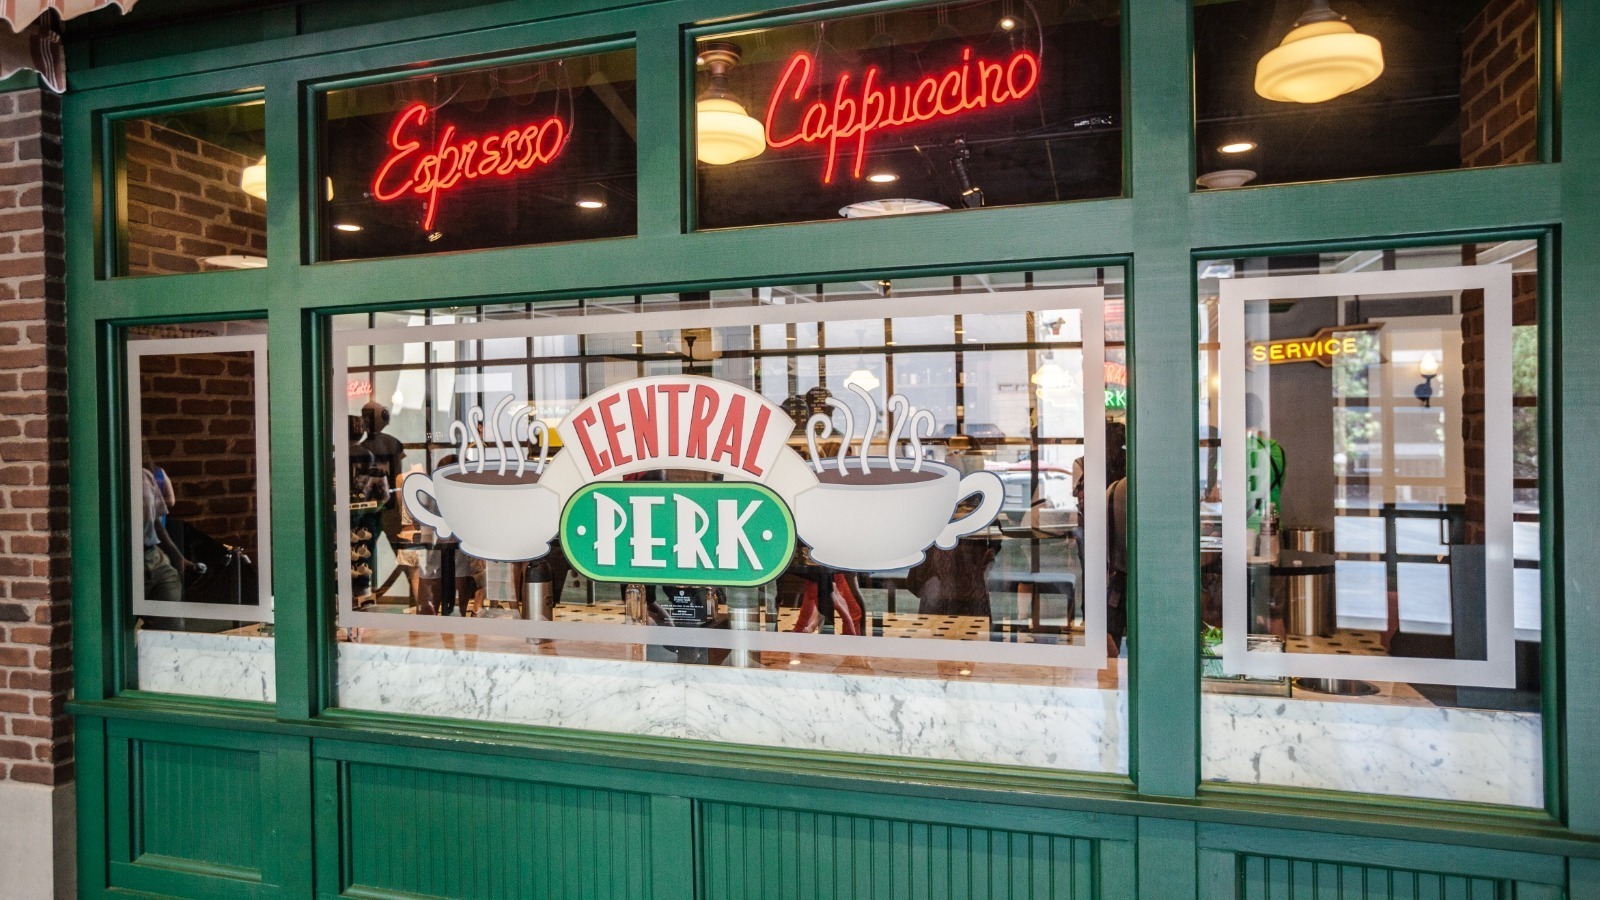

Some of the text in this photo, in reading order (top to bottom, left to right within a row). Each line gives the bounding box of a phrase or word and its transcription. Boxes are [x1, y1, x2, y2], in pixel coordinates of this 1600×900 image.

[765, 48, 1037, 183] Cappuccino
[374, 104, 564, 231] Espresso
[1252, 337, 1357, 361] SERVICE
[571, 383, 772, 477] CENTRAL
[1104, 390, 1126, 407] RK
[593, 491, 764, 570] PERK
